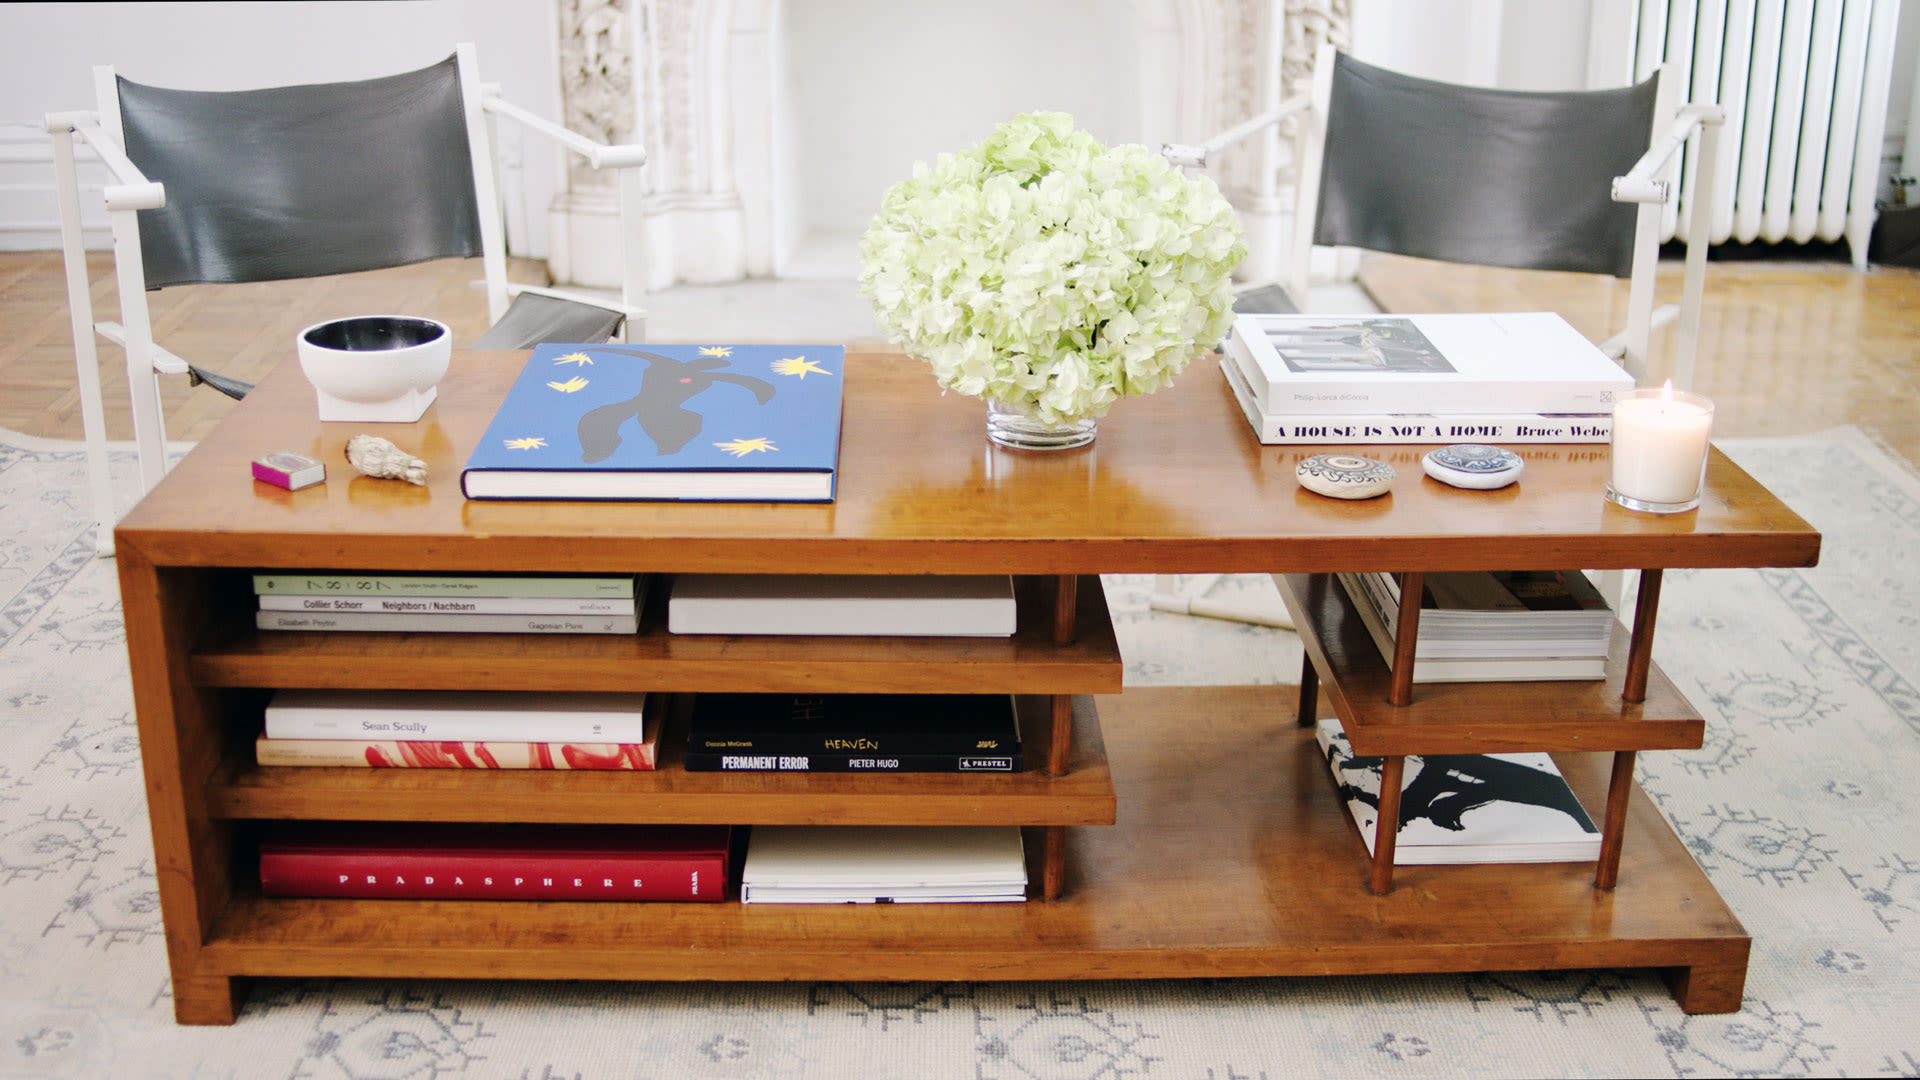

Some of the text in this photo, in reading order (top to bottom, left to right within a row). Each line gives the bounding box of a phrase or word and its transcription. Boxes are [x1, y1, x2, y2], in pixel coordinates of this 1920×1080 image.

[1275, 426, 1502, 437] A HOUSE IS NOT A HOME
[1516, 426, 1611, 437] Bruce Webe
[303, 600, 363, 609] Collier Schorr
[382, 601, 427, 611] Neighbors
[434, 602, 475, 611] Nachbarn
[362, 721, 427, 733] Sean Scully
[825, 738, 879, 750] HEAVEN
[722, 756, 809, 770] PERMANENT ERROR
[849, 759, 899, 768] PIETER HUGO
